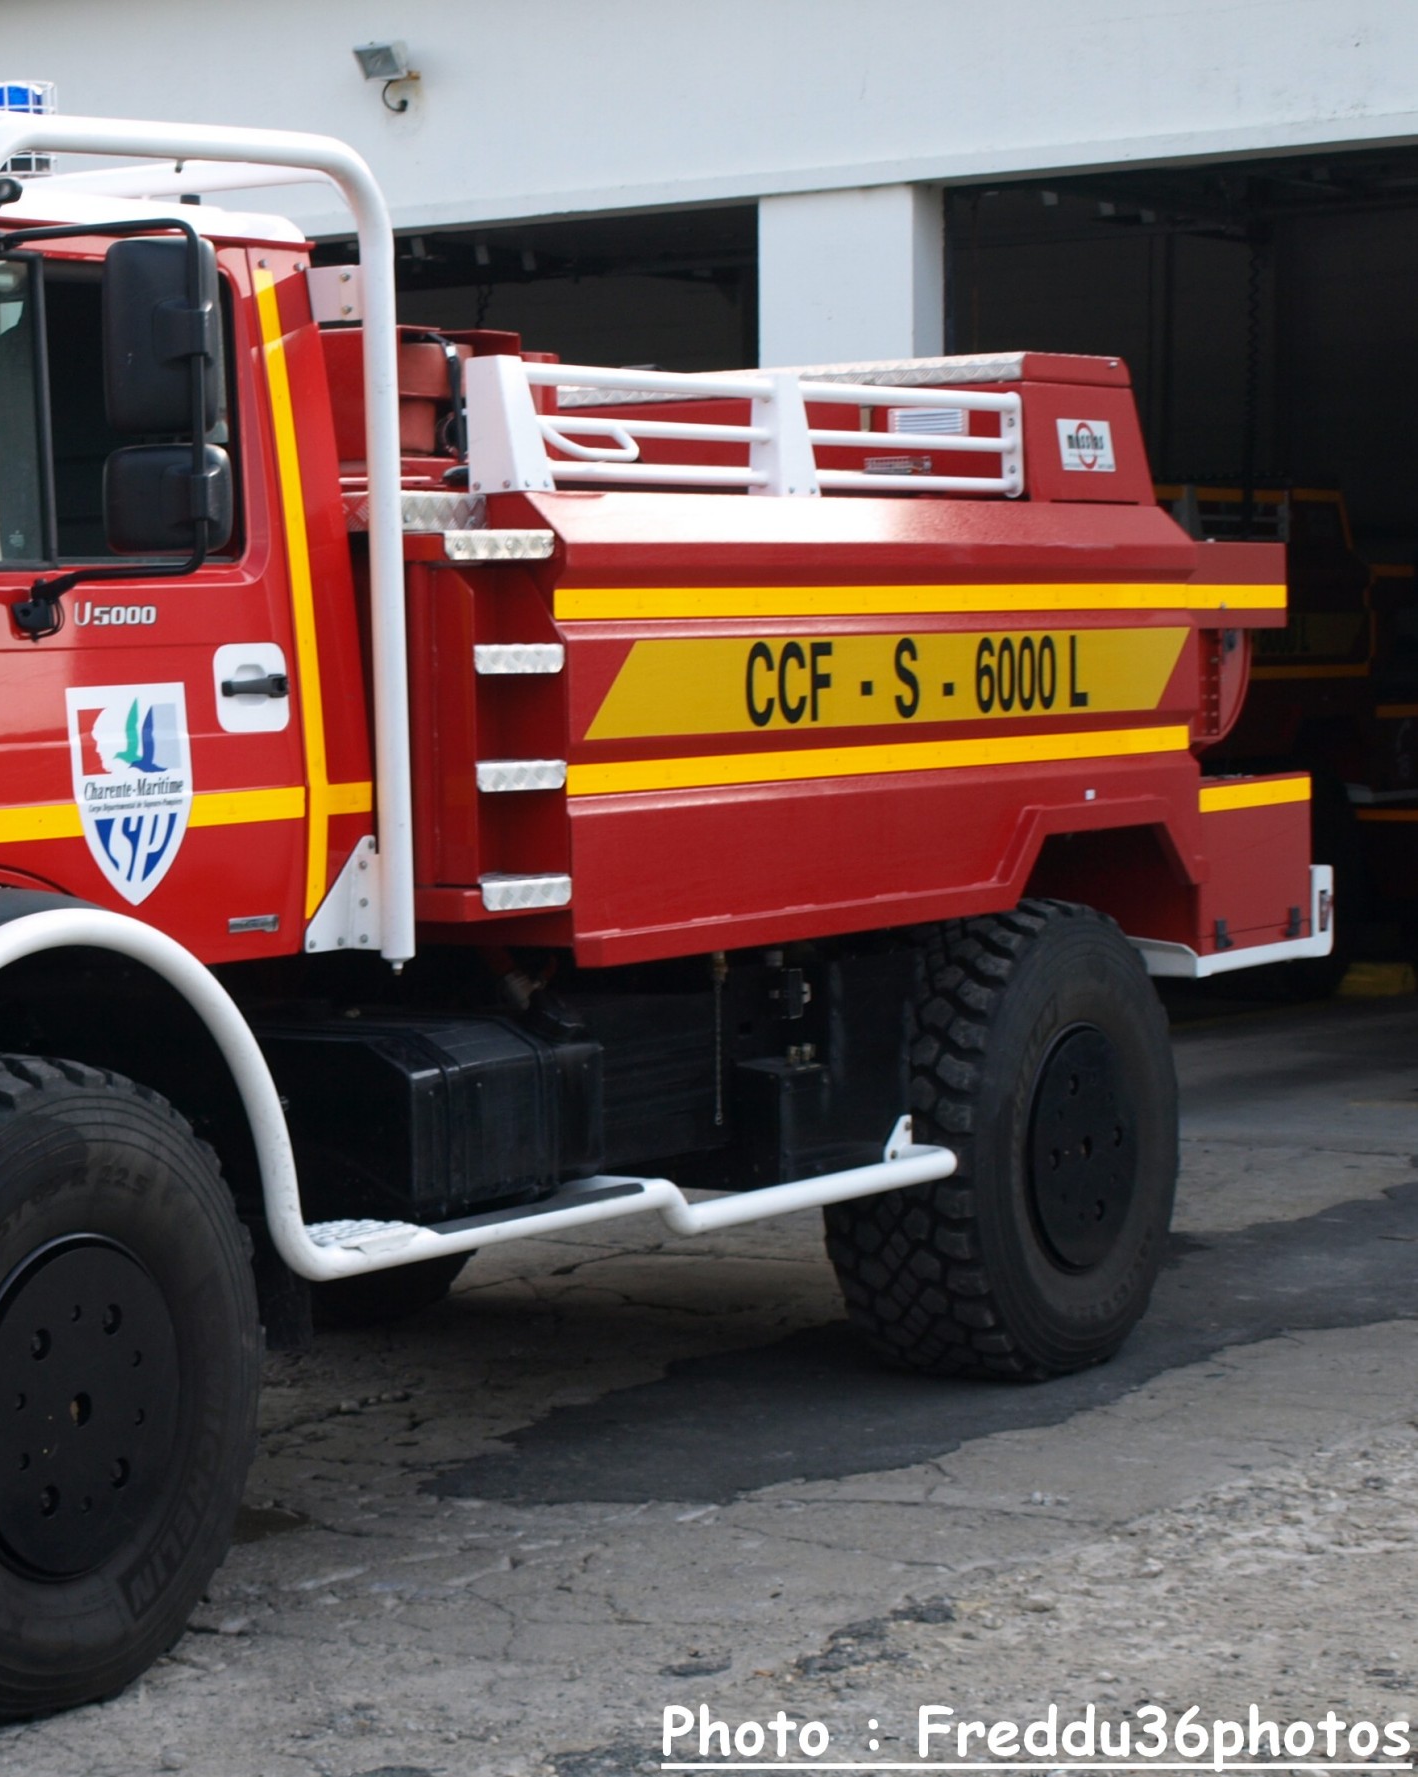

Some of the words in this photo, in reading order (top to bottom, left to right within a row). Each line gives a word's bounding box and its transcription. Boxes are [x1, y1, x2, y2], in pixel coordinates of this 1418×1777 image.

[745, 641, 834, 728] CCF
[893, 637, 920, 719] S
[974, 635, 1057, 714] 6000
[1068, 635, 1089, 708] L
[83, 776, 184, 802] Charente-Maritime
